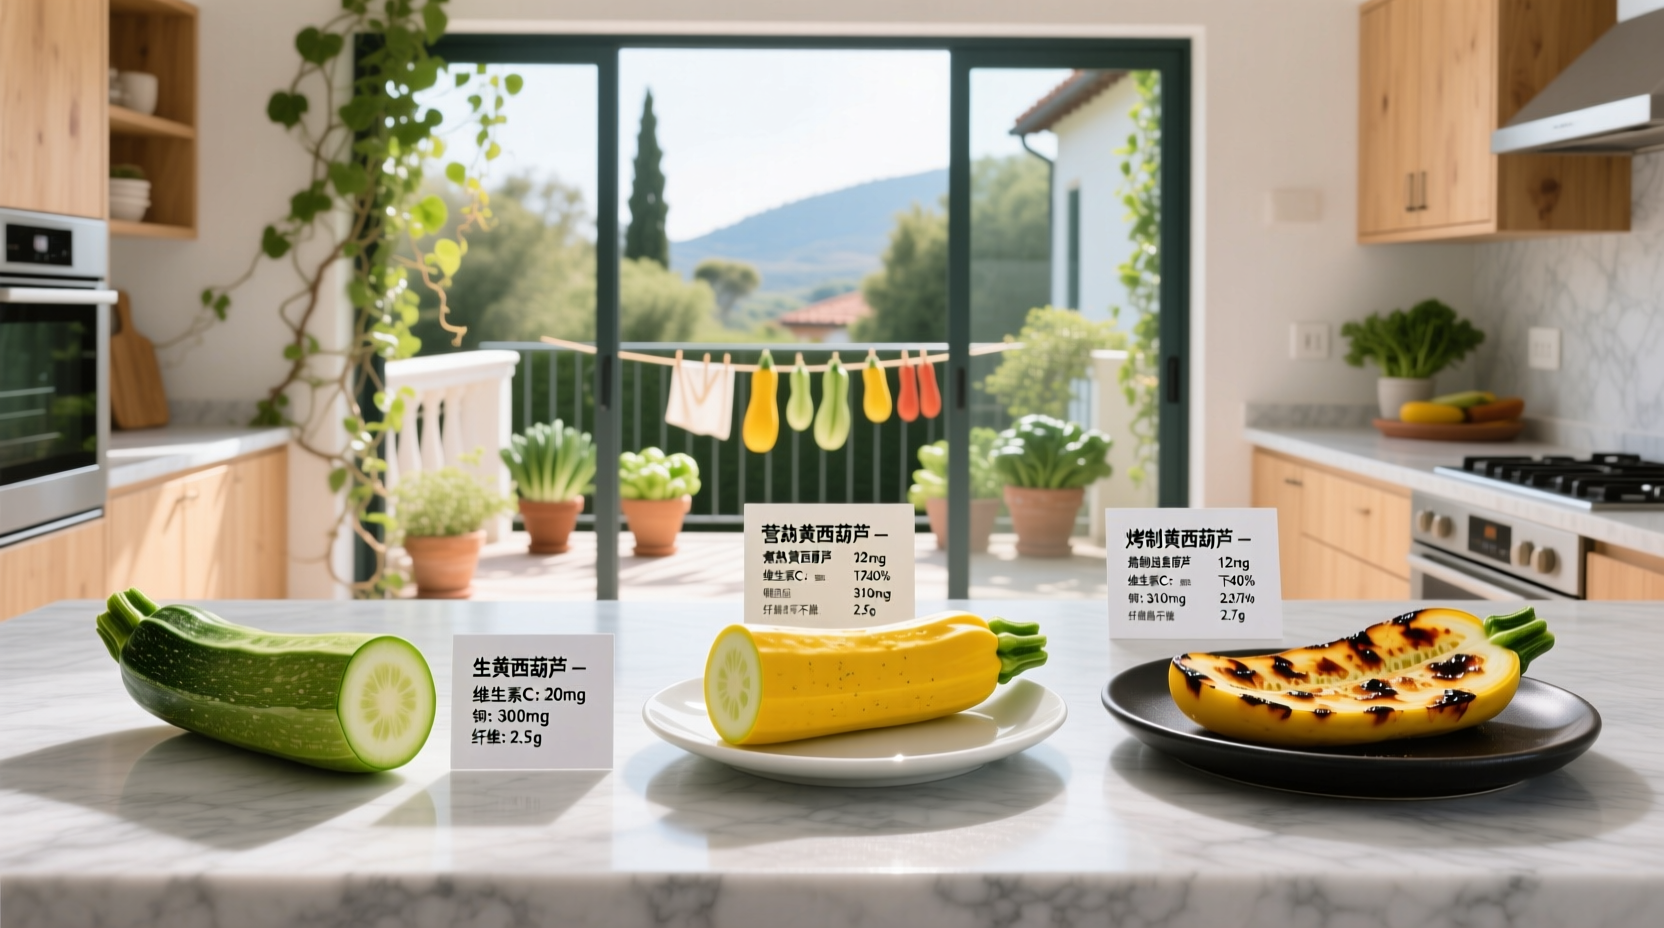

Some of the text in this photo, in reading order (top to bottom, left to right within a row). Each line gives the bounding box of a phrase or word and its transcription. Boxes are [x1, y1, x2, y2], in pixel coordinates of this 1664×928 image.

[1125, 527, 1234, 550] 烤制黄西葫芦
[1147, 592, 1187, 608] 310mg
[1219, 608, 1246, 624] 2.7g
[473, 655, 568, 679] 生黄西葫芦
[472, 684, 586, 706] 维生素C: 20mg
[498, 708, 549, 728] 300mg
[510, 730, 542, 749] 2.5g
